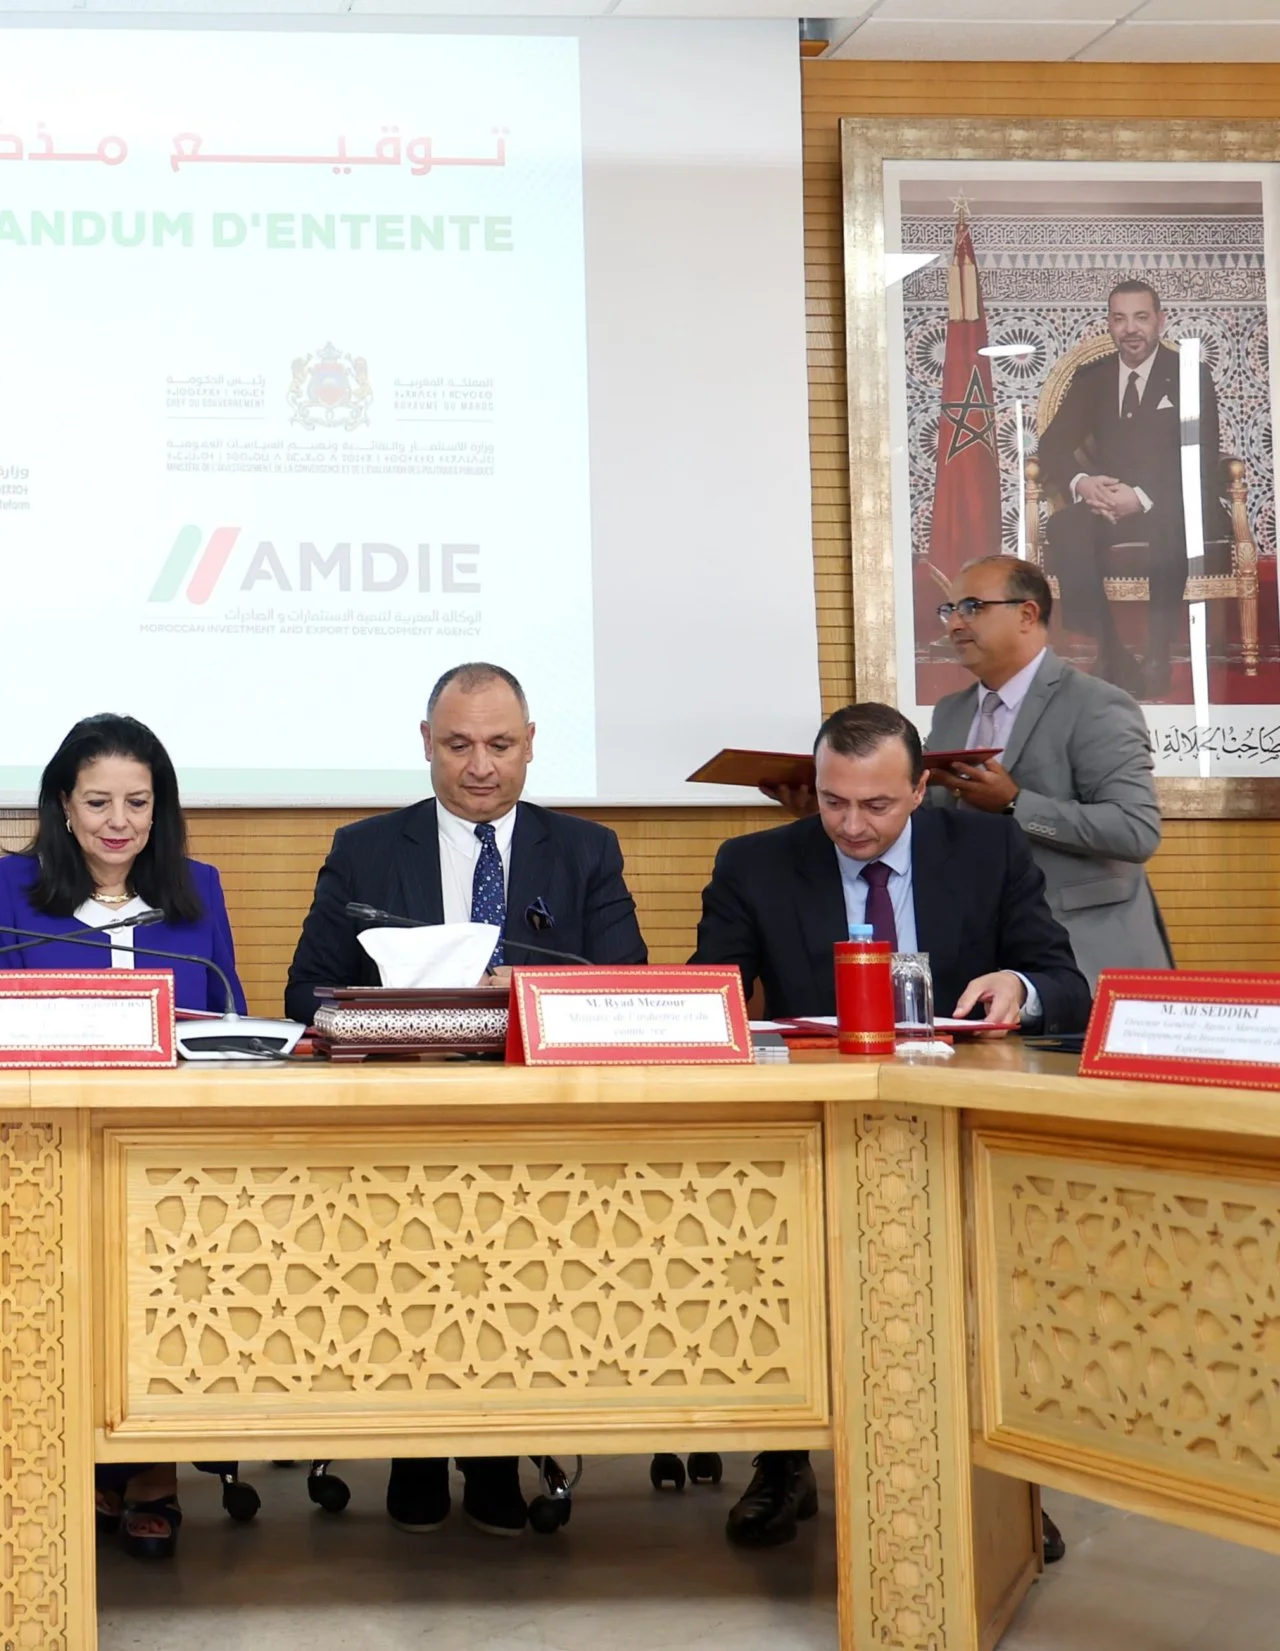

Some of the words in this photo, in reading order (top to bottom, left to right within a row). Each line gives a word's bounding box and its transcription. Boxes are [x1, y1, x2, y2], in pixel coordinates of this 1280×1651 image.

[213, 210, 514, 252] D'ENTENTE
[240, 541, 482, 593] AMDIE
[140, 624, 206, 634] MOROCCAN
[207, 624, 276, 634] INVESTMENT
[280, 625, 304, 635] AND
[306, 625, 349, 635] EXPORT
[352, 625, 432, 636] DEVELOPMENT
[436, 626, 482, 636] AGENCY
[1180, 1005, 1197, 1017] Ali
[1199, 1006, 1260, 1020] SEDDIKI
